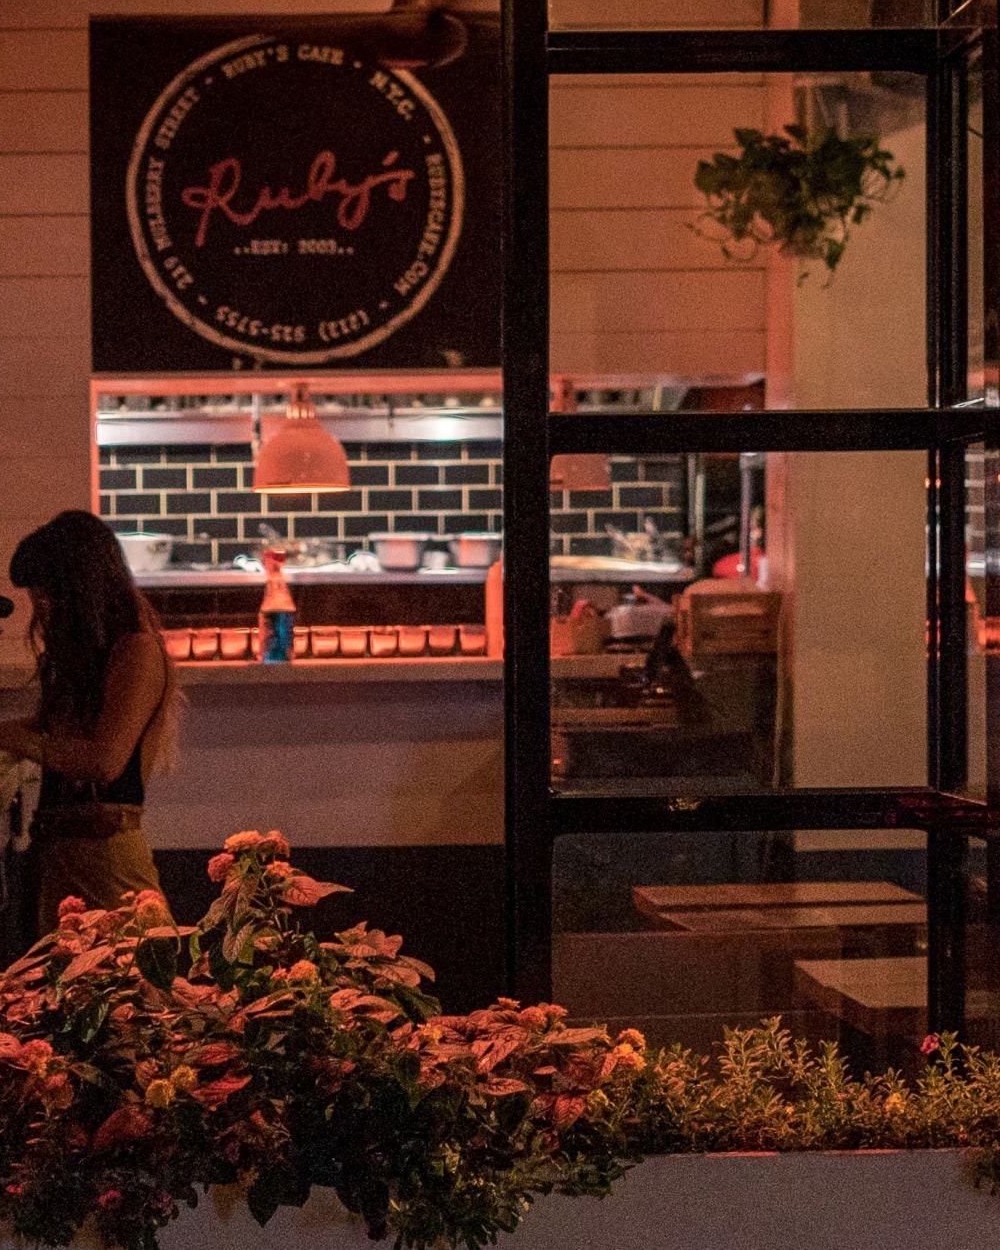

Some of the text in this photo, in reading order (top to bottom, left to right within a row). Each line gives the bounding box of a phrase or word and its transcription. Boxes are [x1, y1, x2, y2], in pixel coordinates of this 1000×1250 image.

[220, 44, 290, 79] RUBY'S
[154, 86, 200, 151] STREET
[181, 150, 416, 248] Ruby's
